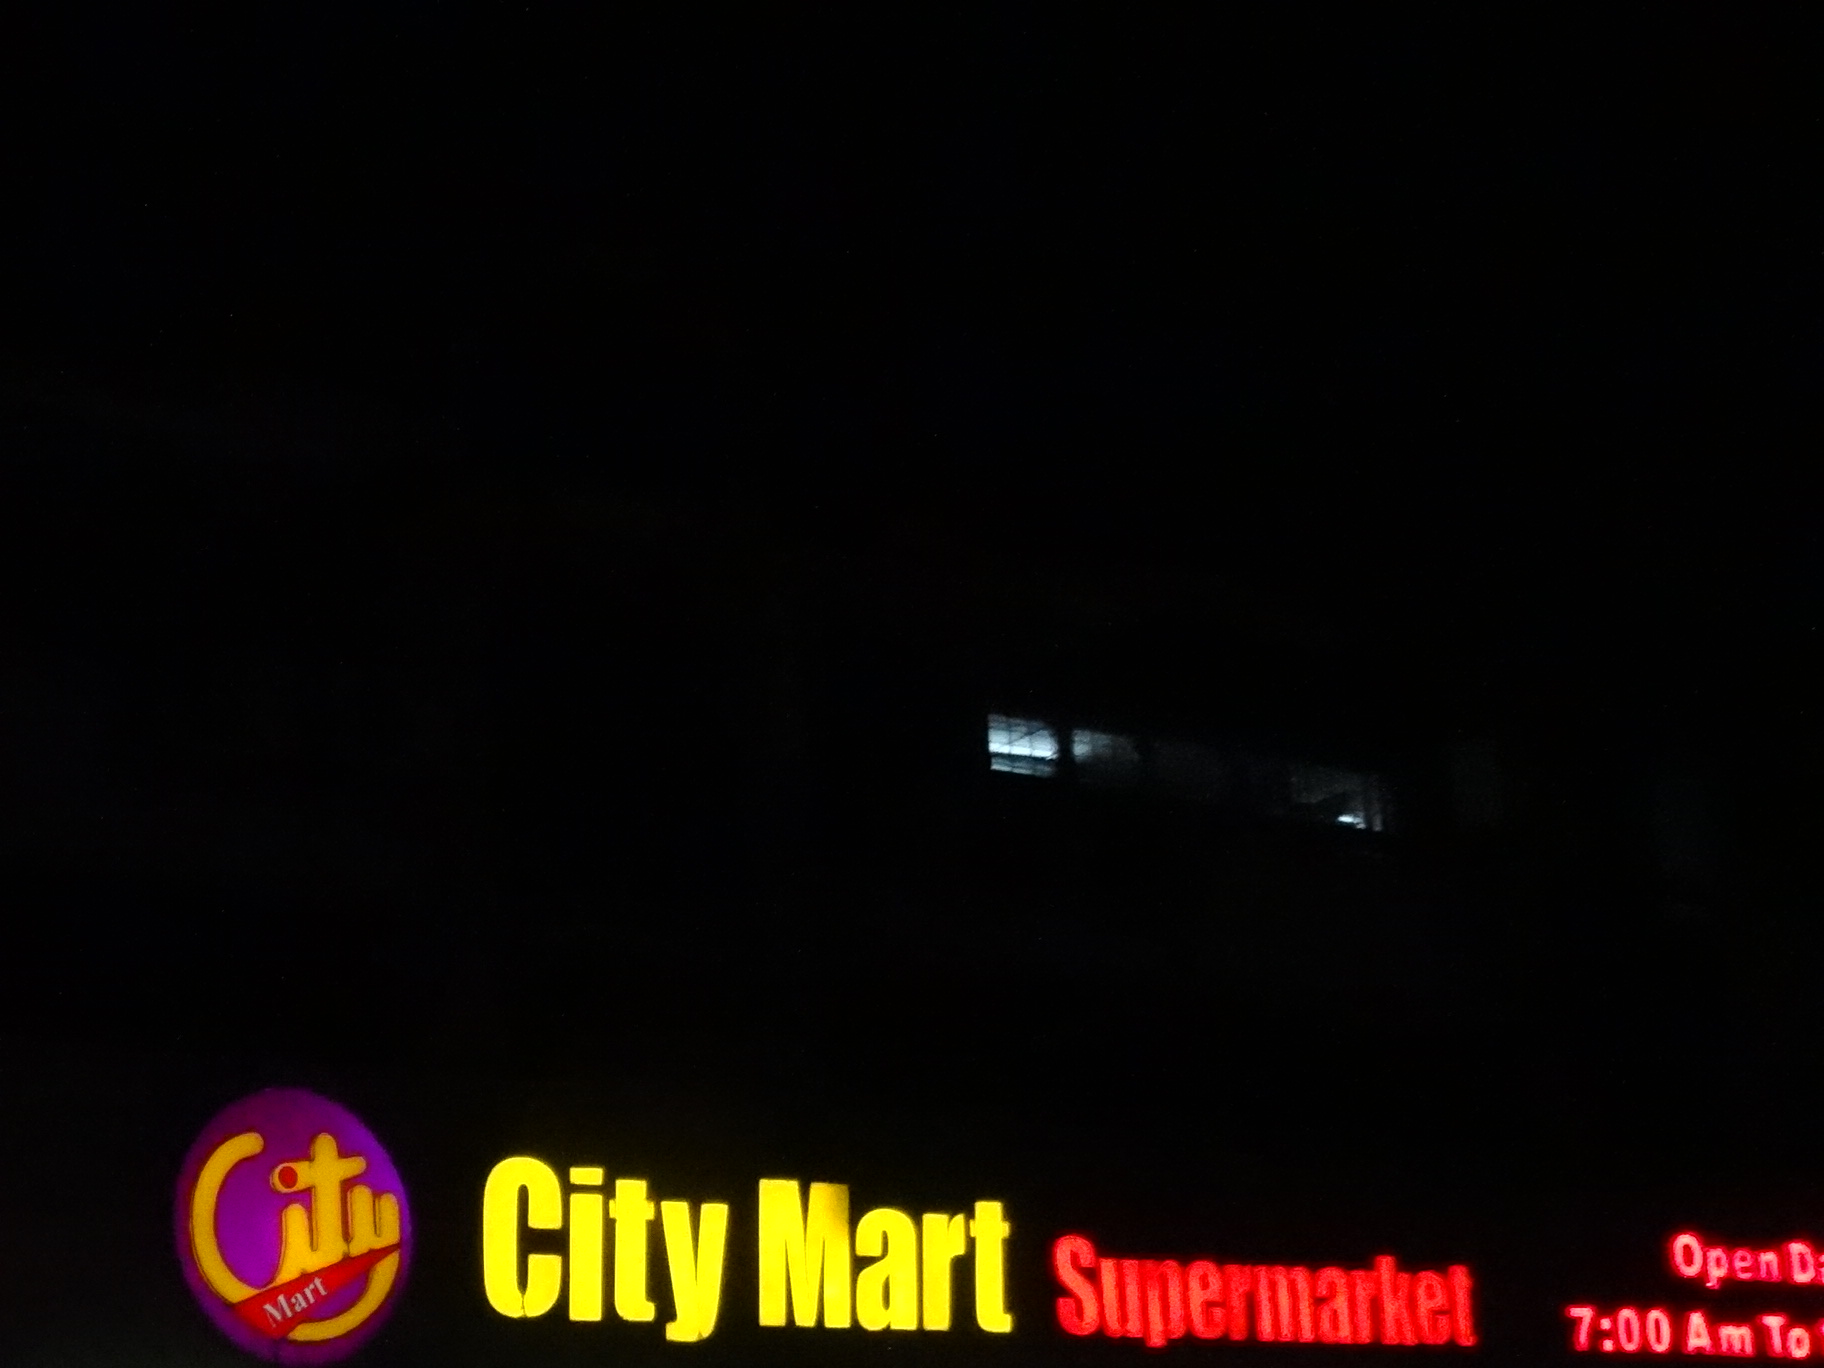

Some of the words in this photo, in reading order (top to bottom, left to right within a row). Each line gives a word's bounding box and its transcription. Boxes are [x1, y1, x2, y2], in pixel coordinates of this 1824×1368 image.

[482, 1156, 729, 1343] City
[757, 1178, 1013, 1334] Mart
[1052, 1233, 1478, 1349] Supermarket
[1671, 1232, 1781, 1289] Open
[262, 1276, 328, 1328] Mart
[1568, 1305, 1674, 1354] 7:00
[1682, 1310, 1757, 1357] Am
[1759, 1314, 1812, 1360] To
